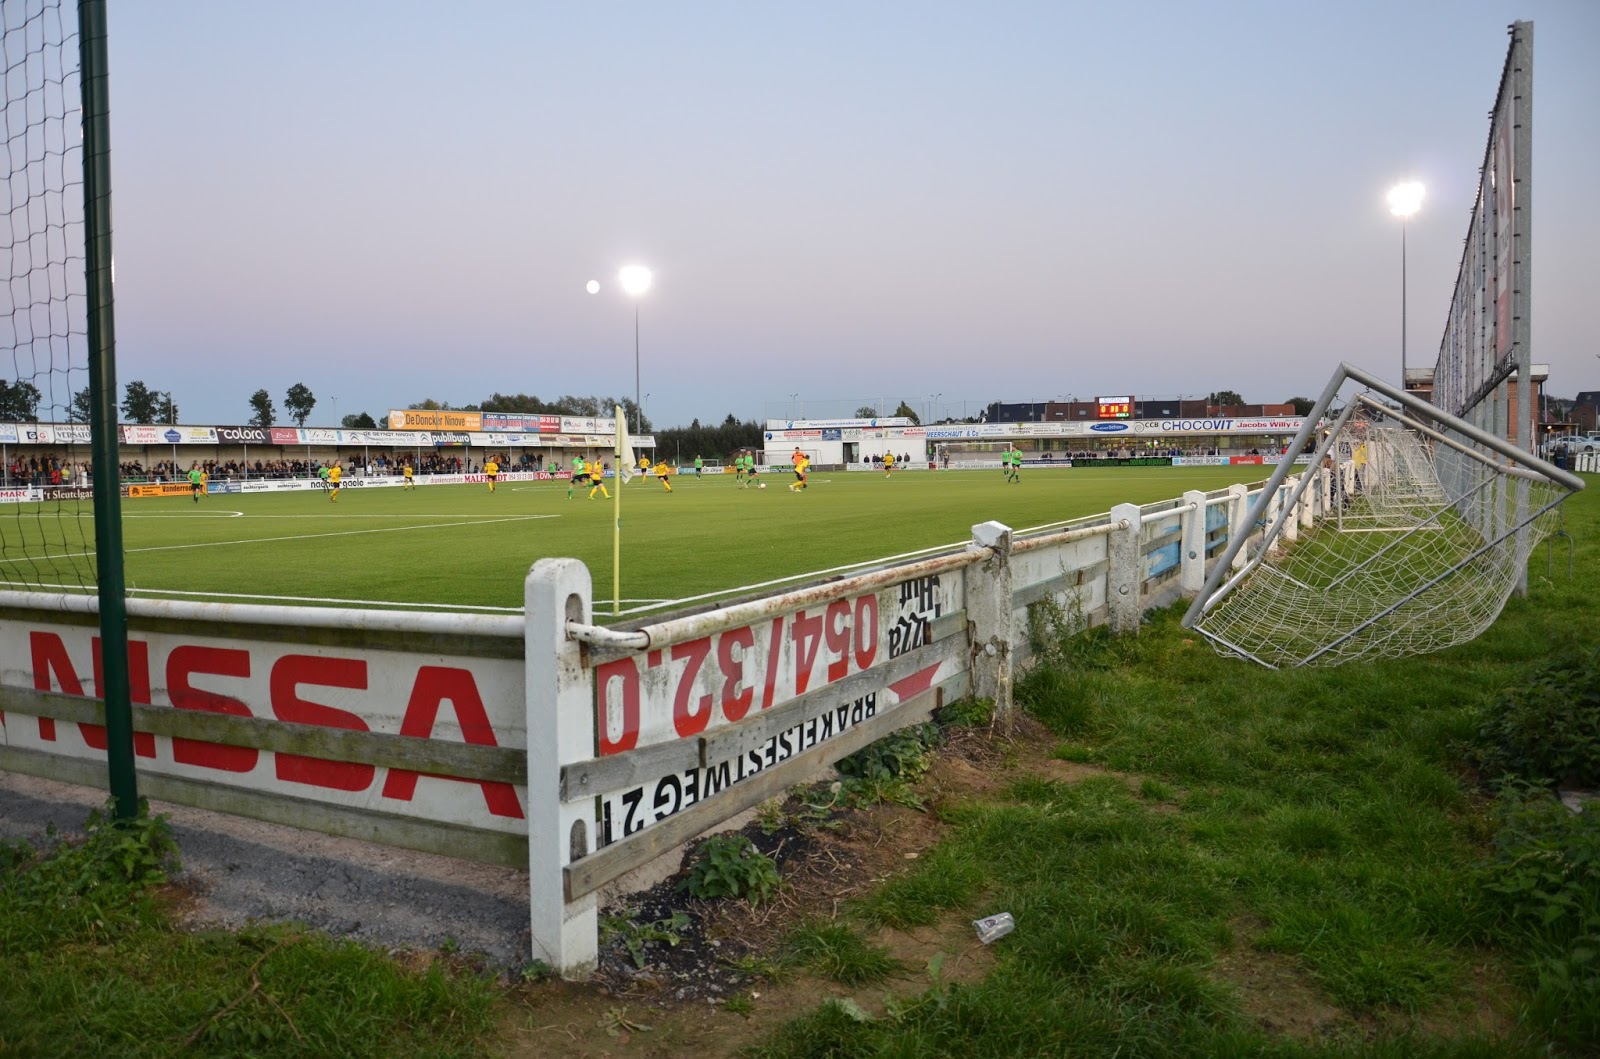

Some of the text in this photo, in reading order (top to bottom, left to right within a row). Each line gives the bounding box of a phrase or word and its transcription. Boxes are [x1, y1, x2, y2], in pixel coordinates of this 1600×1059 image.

[406, 413, 415, 425] De
[416, 414, 443, 427] Doncker
[445, 415, 466, 427] Ninove
[1162, 419, 1234, 431] CHOCOVIT
[223, 427, 265, 440] colora
[431, 432, 470, 445] publiburo
[53, 489, 93, 500] Sleutelgat
[653, 691, 876, 822] BRAKELSESTWEG
